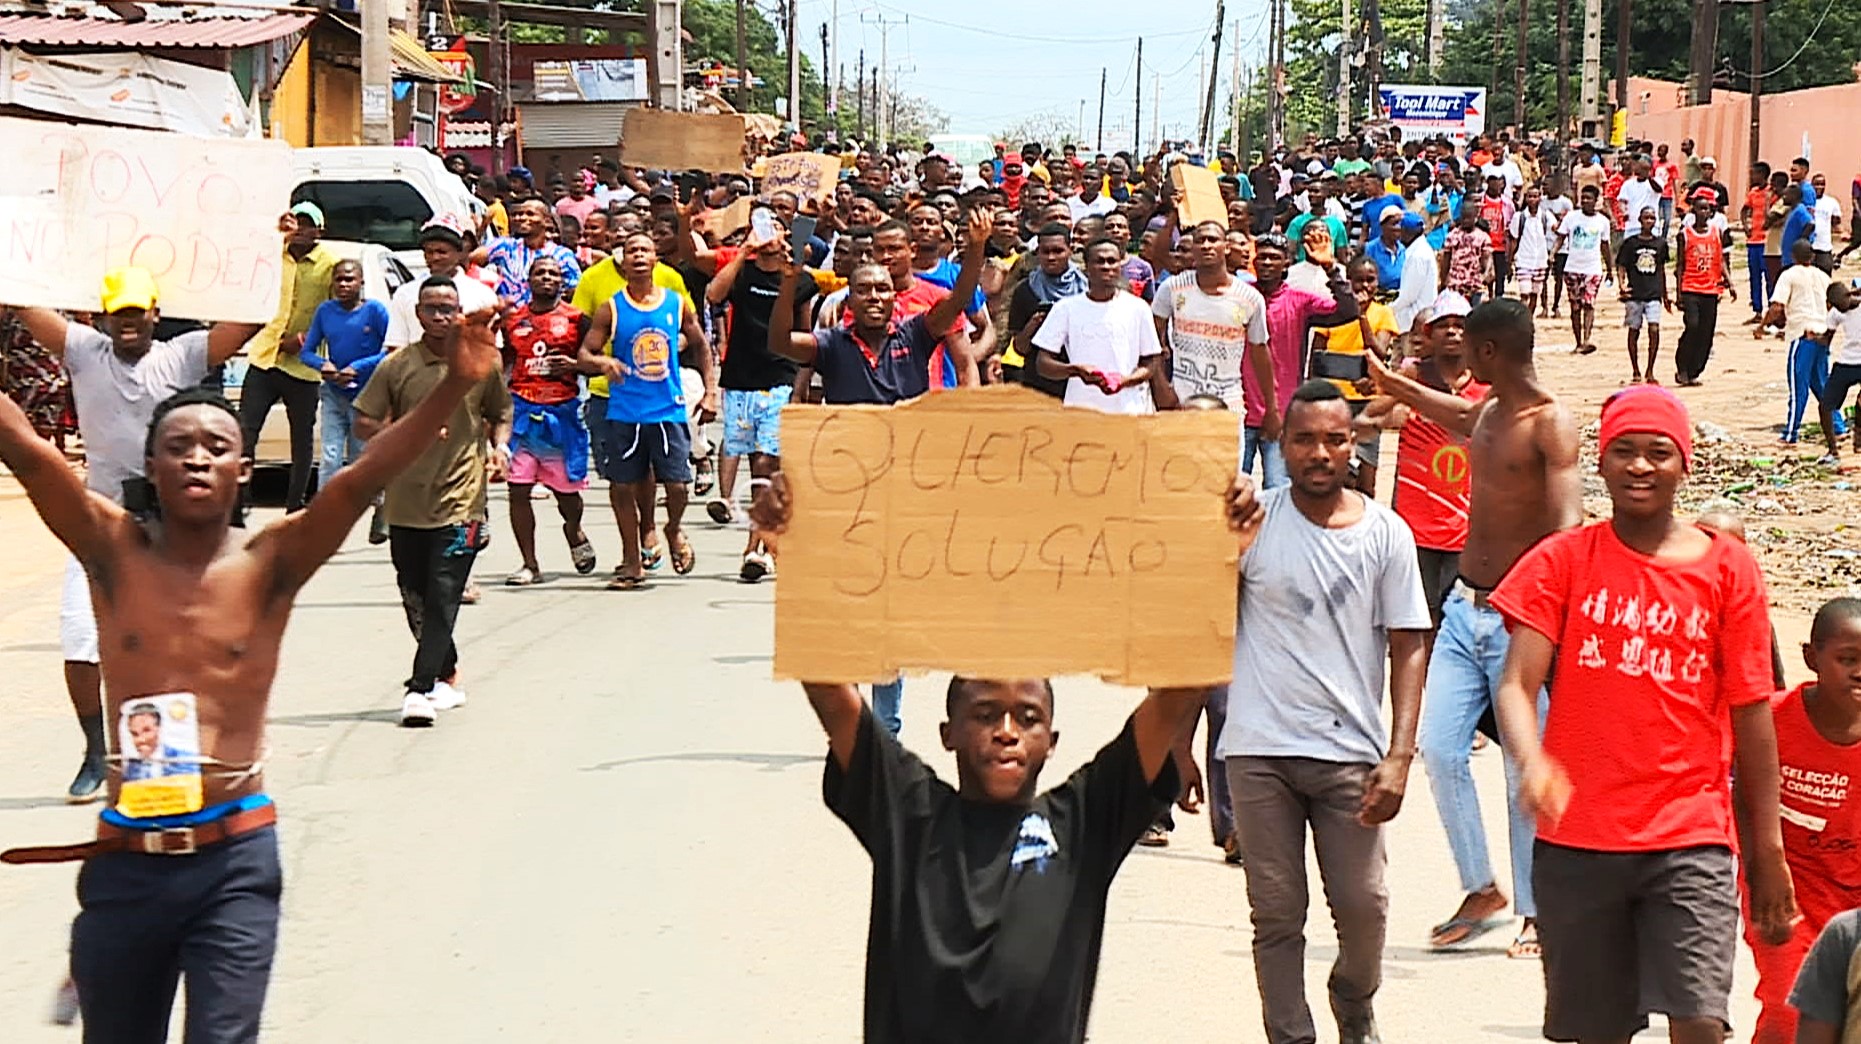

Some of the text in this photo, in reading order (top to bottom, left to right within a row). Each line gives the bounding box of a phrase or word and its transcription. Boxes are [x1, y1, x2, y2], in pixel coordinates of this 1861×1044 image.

[431, 37, 448, 50] 2
[1395, 97, 1461, 110] Tool Mart
[40, 133, 242, 216] POVO
[95, 210, 276, 304] PODER
[809, 412, 1229, 504] QUEREMOS
[831, 509, 1169, 598] SOLUÇÃO
